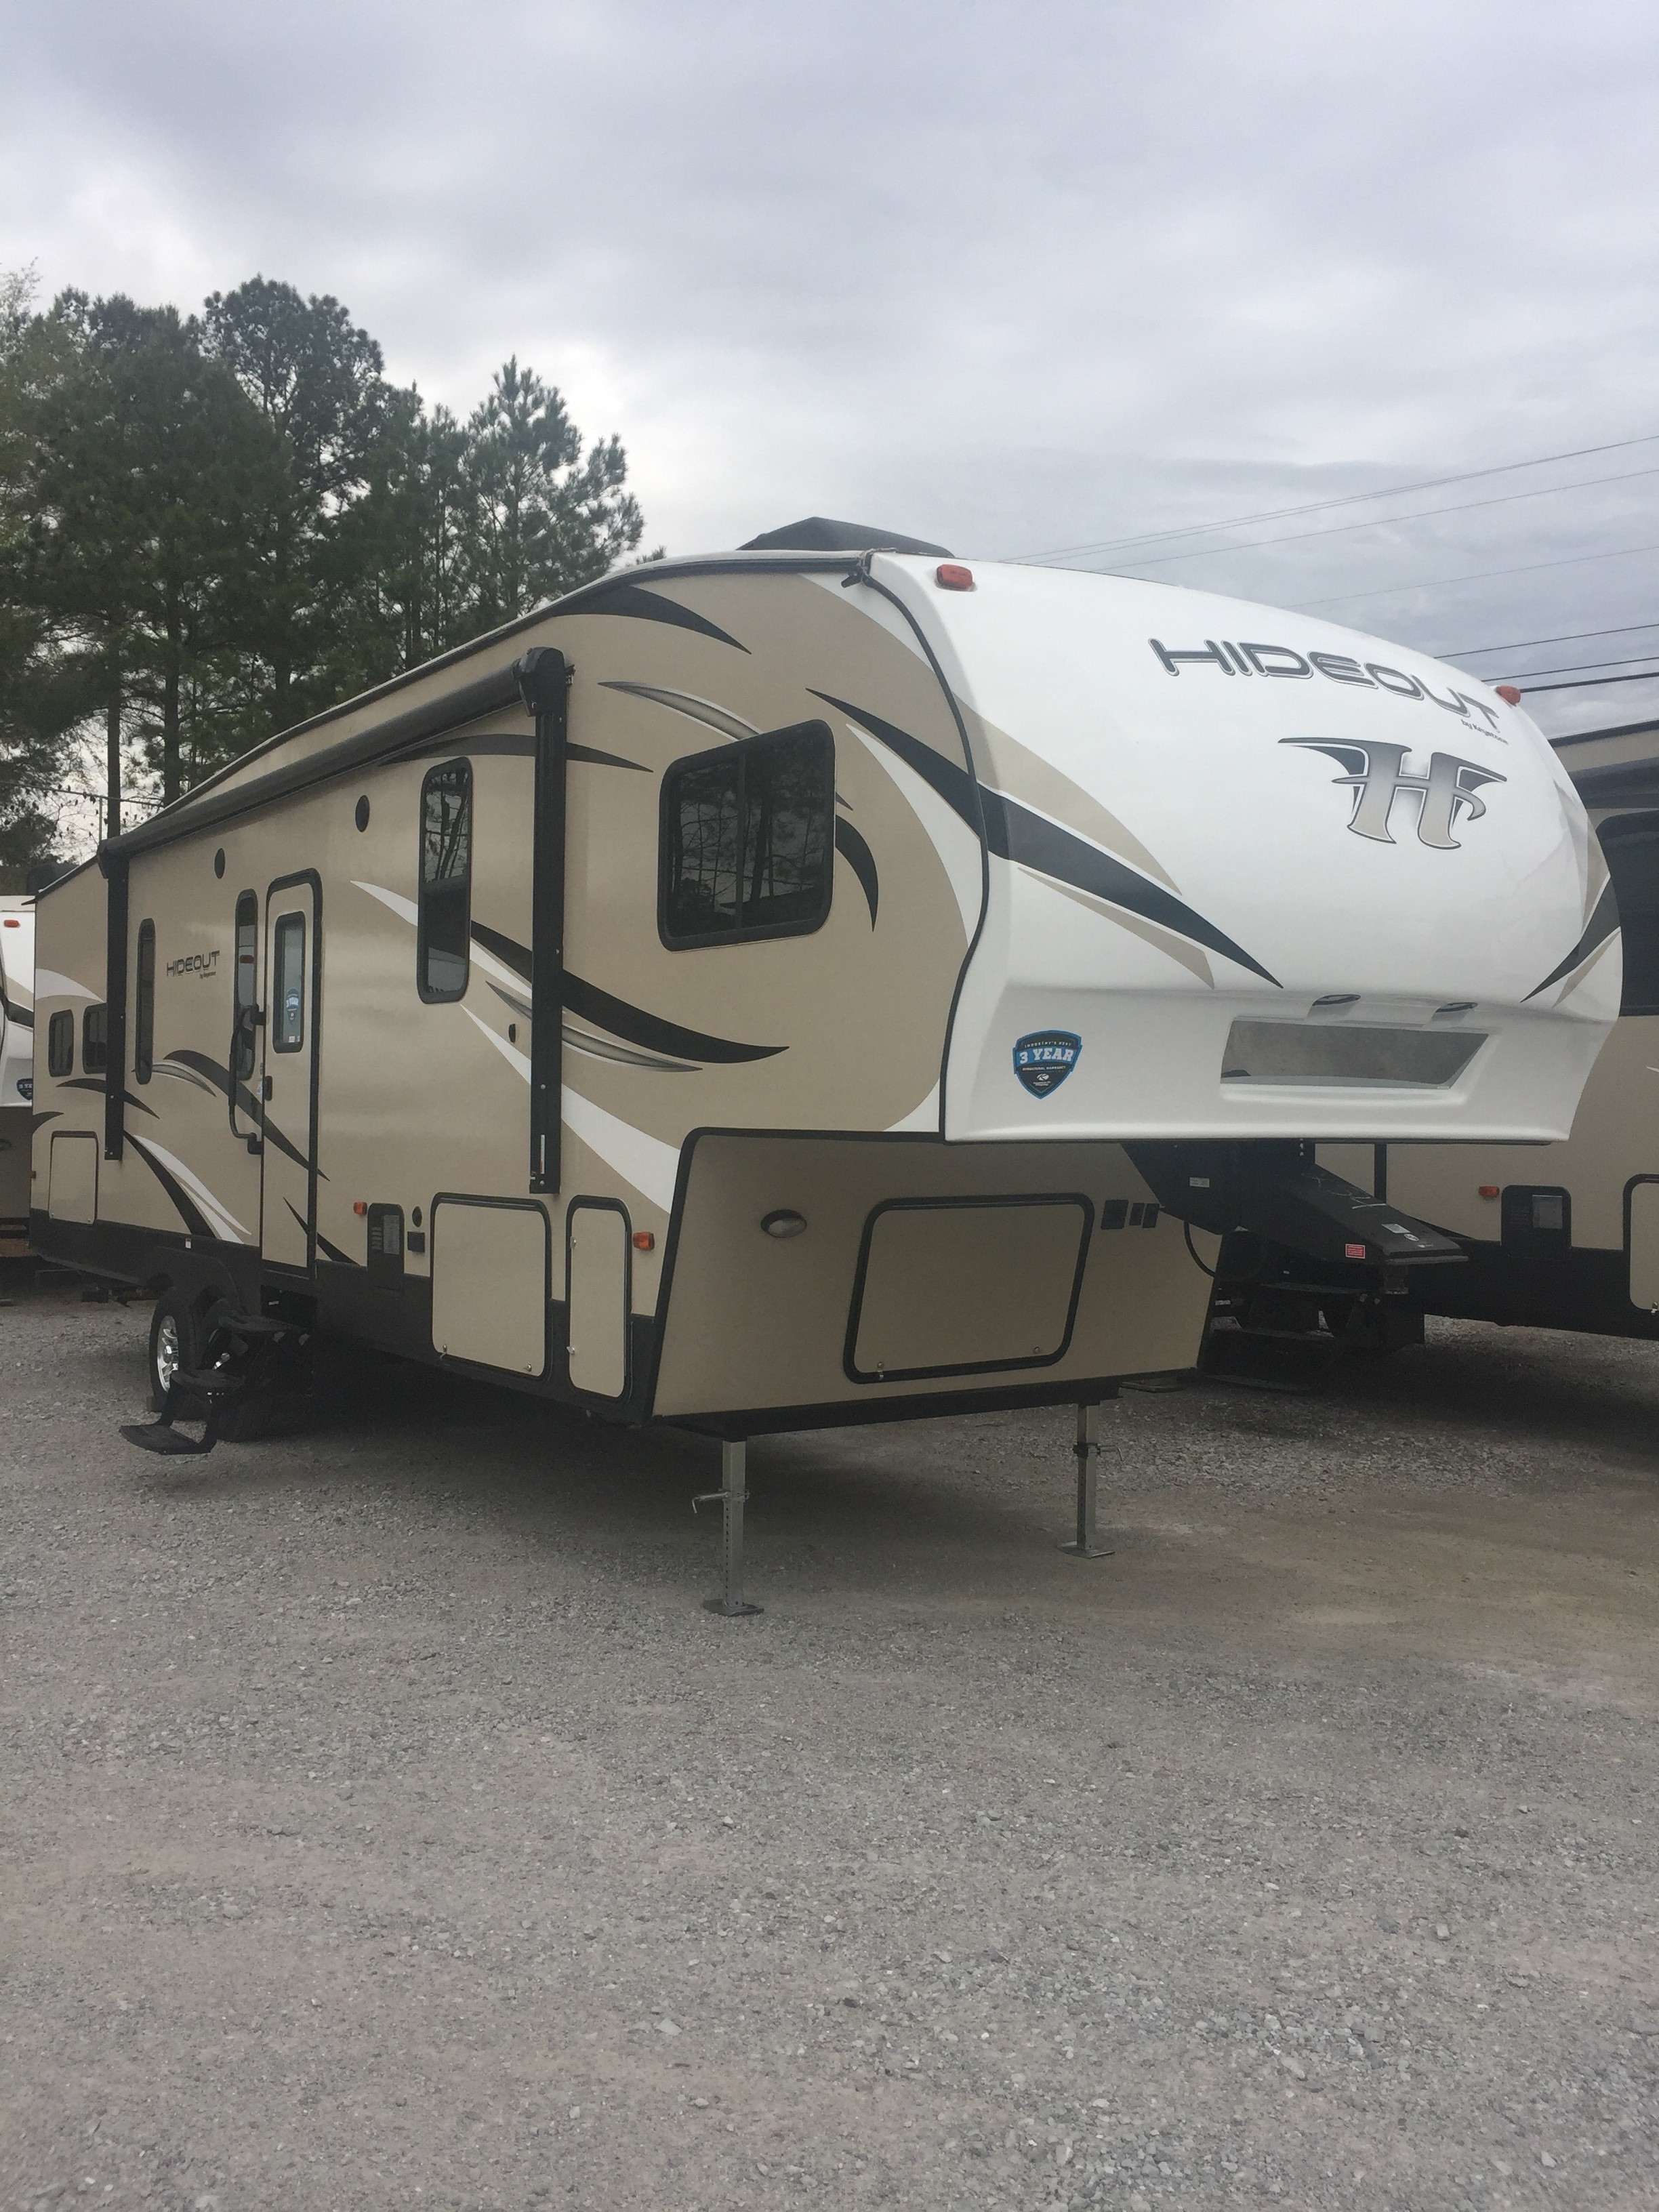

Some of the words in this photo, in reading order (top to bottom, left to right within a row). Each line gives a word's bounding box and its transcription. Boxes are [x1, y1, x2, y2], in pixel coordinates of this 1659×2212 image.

[1147, 638, 1500, 733] HIDEOUT
[167, 950, 220, 977] HIDEOUT
[1019, 1051, 1028, 1064] 3
[1033, 1047, 1074, 1062] YEAR
